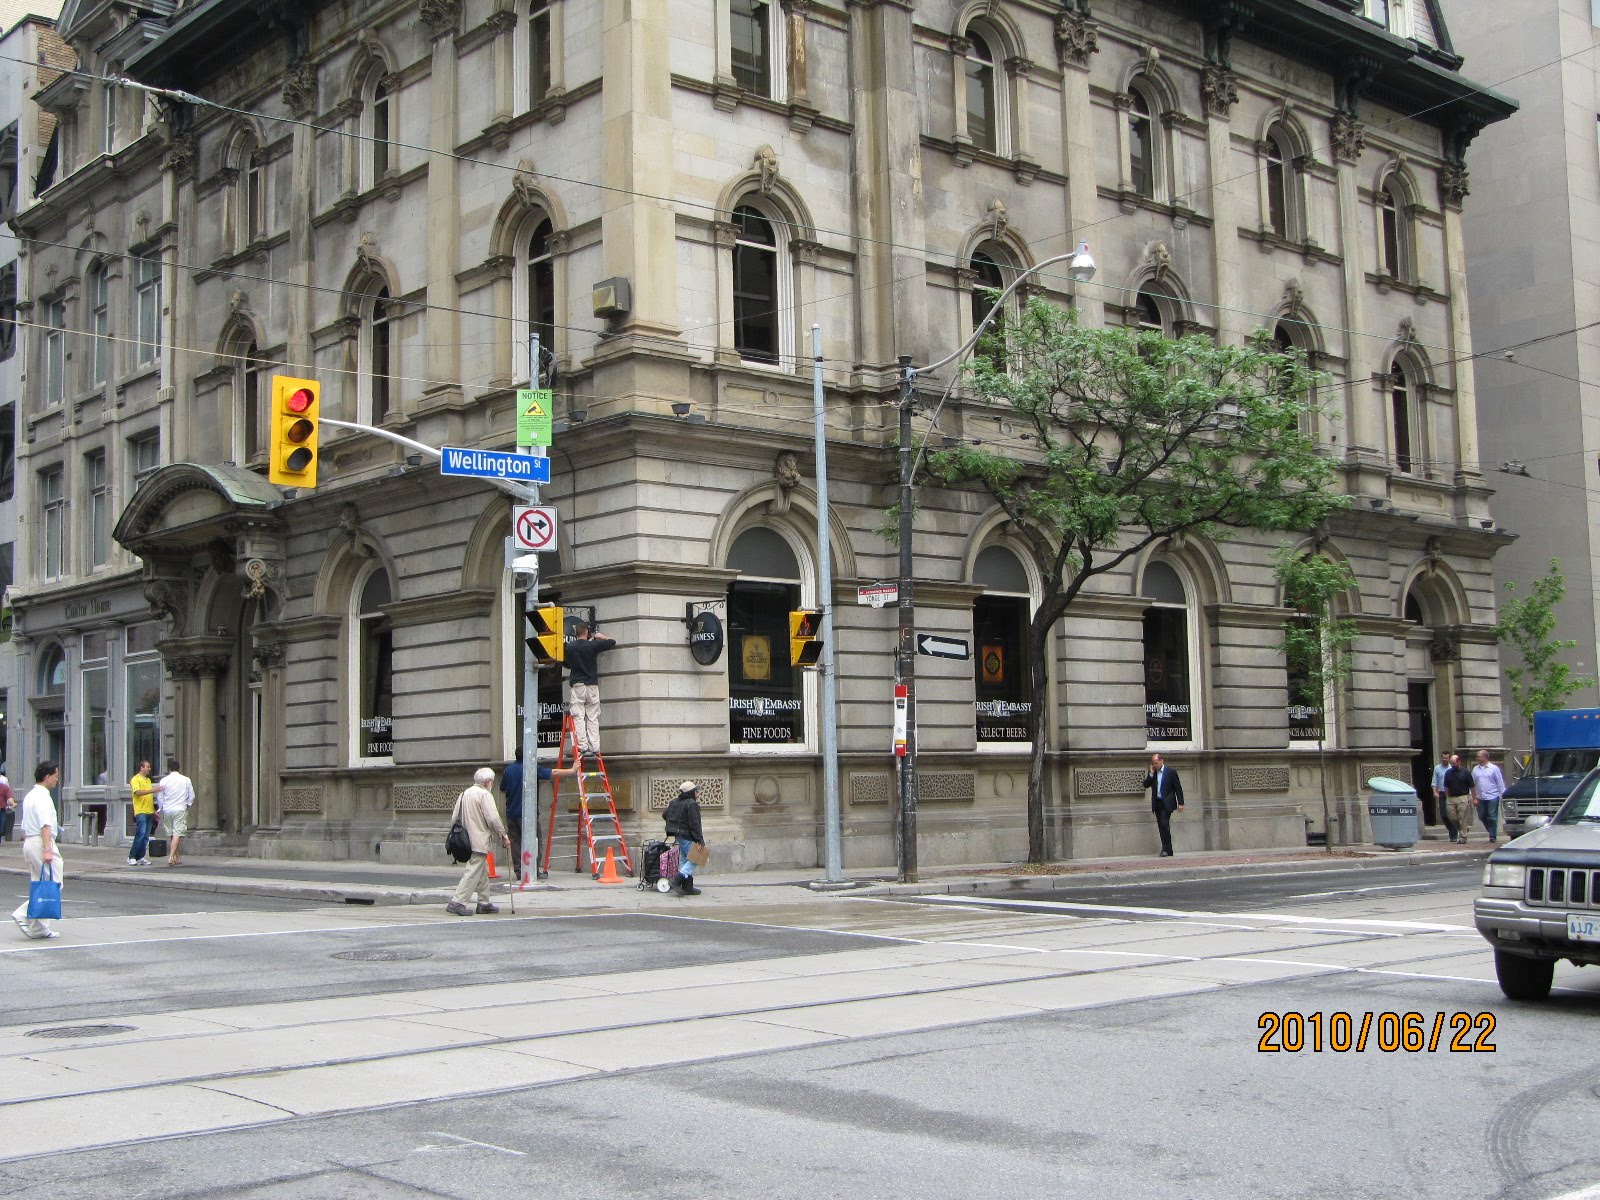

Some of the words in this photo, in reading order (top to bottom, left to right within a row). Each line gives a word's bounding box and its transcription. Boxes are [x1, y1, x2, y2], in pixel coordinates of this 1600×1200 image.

[522, 392, 548, 400] NOTICE
[449, 450, 531, 476] Wellington
[534, 458, 542, 469] St
[692, 632, 715, 641] INNESS
[543, 702, 564, 714] EMBAS
[730, 697, 754, 709] IRISH
[764, 697, 802, 710] EMBASSY
[976, 701, 994, 711] RISH
[1001, 700, 1032, 712] EMBASSY
[1164, 703, 1190, 713] EMBASSY
[743, 727, 762, 739] FINE
[763, 727, 792, 739] FOODS
[980, 727, 1005, 738] SELECT
[1006, 727, 1027, 738] BEERS
[1167, 727, 1188, 737] SPIRITS
[367, 742, 379, 753] FINE
